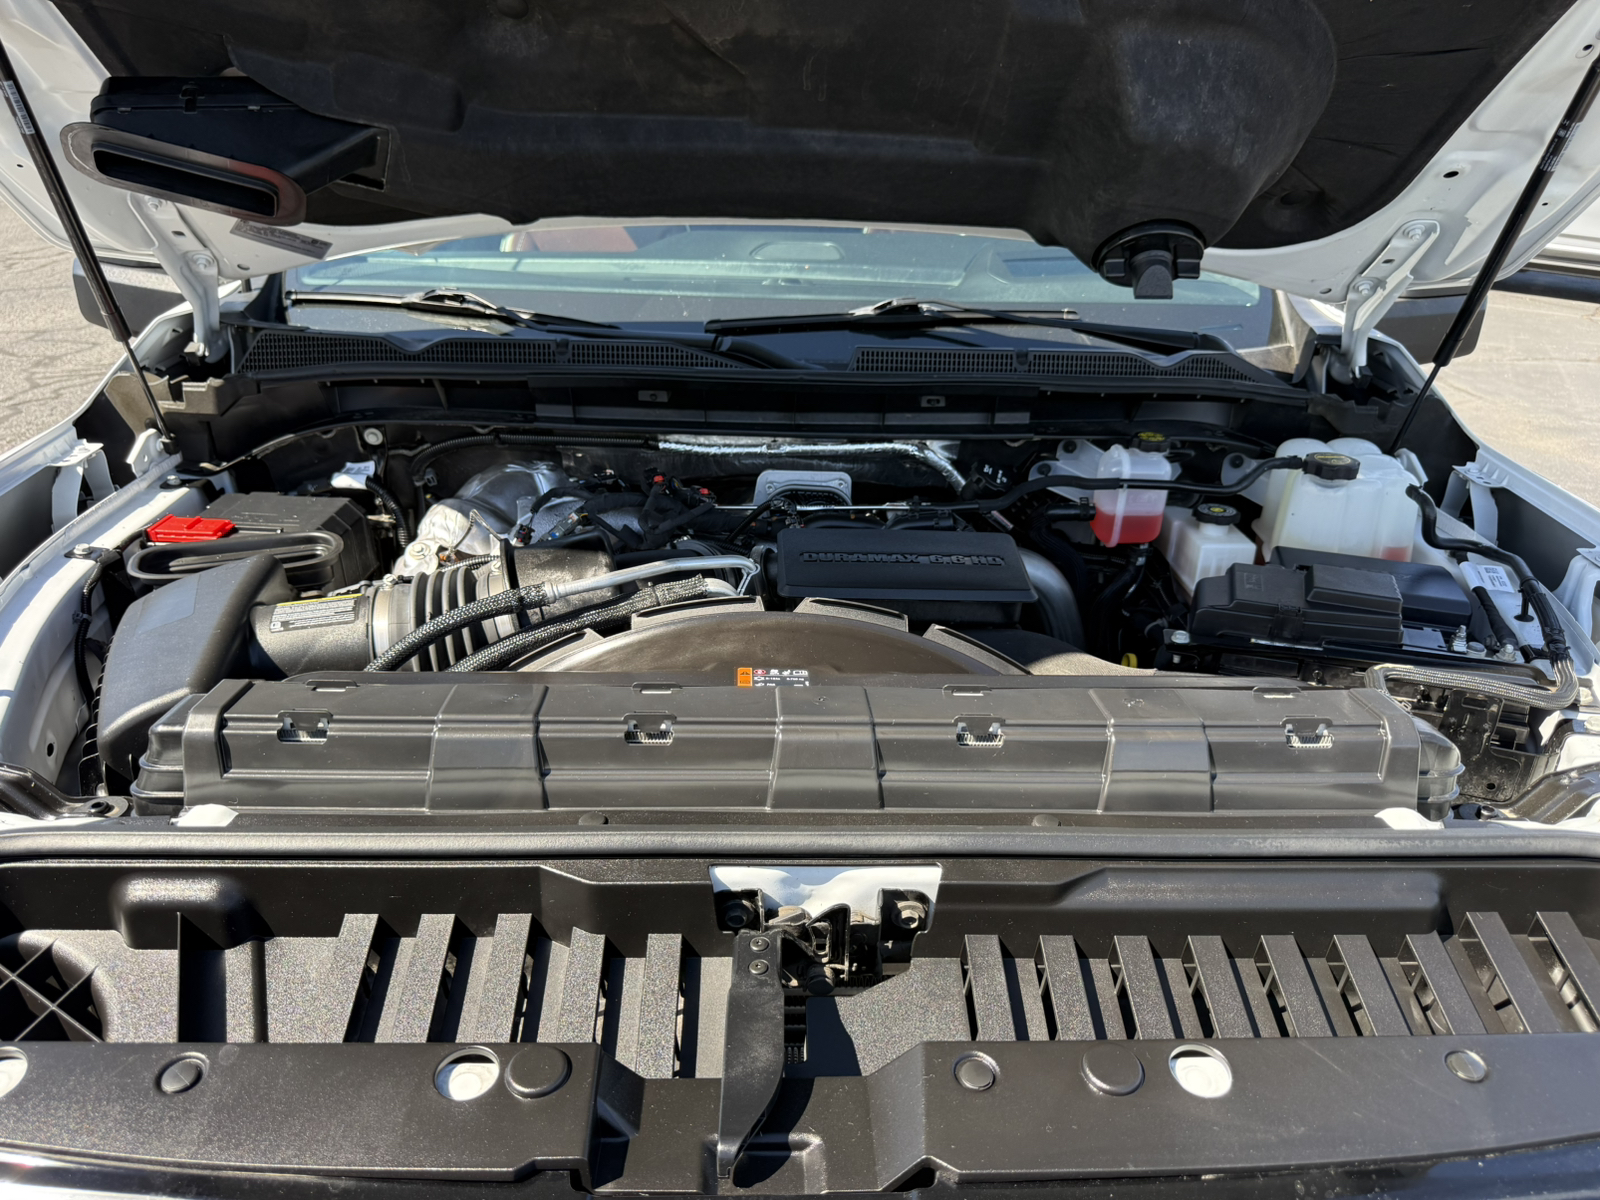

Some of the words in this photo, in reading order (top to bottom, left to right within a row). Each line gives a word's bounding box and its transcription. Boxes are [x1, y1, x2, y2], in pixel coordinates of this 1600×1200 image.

[801, 552, 919, 563] DURAMAX
[929, 553, 966, 565] 6.6
[970, 554, 1005, 566] HD
